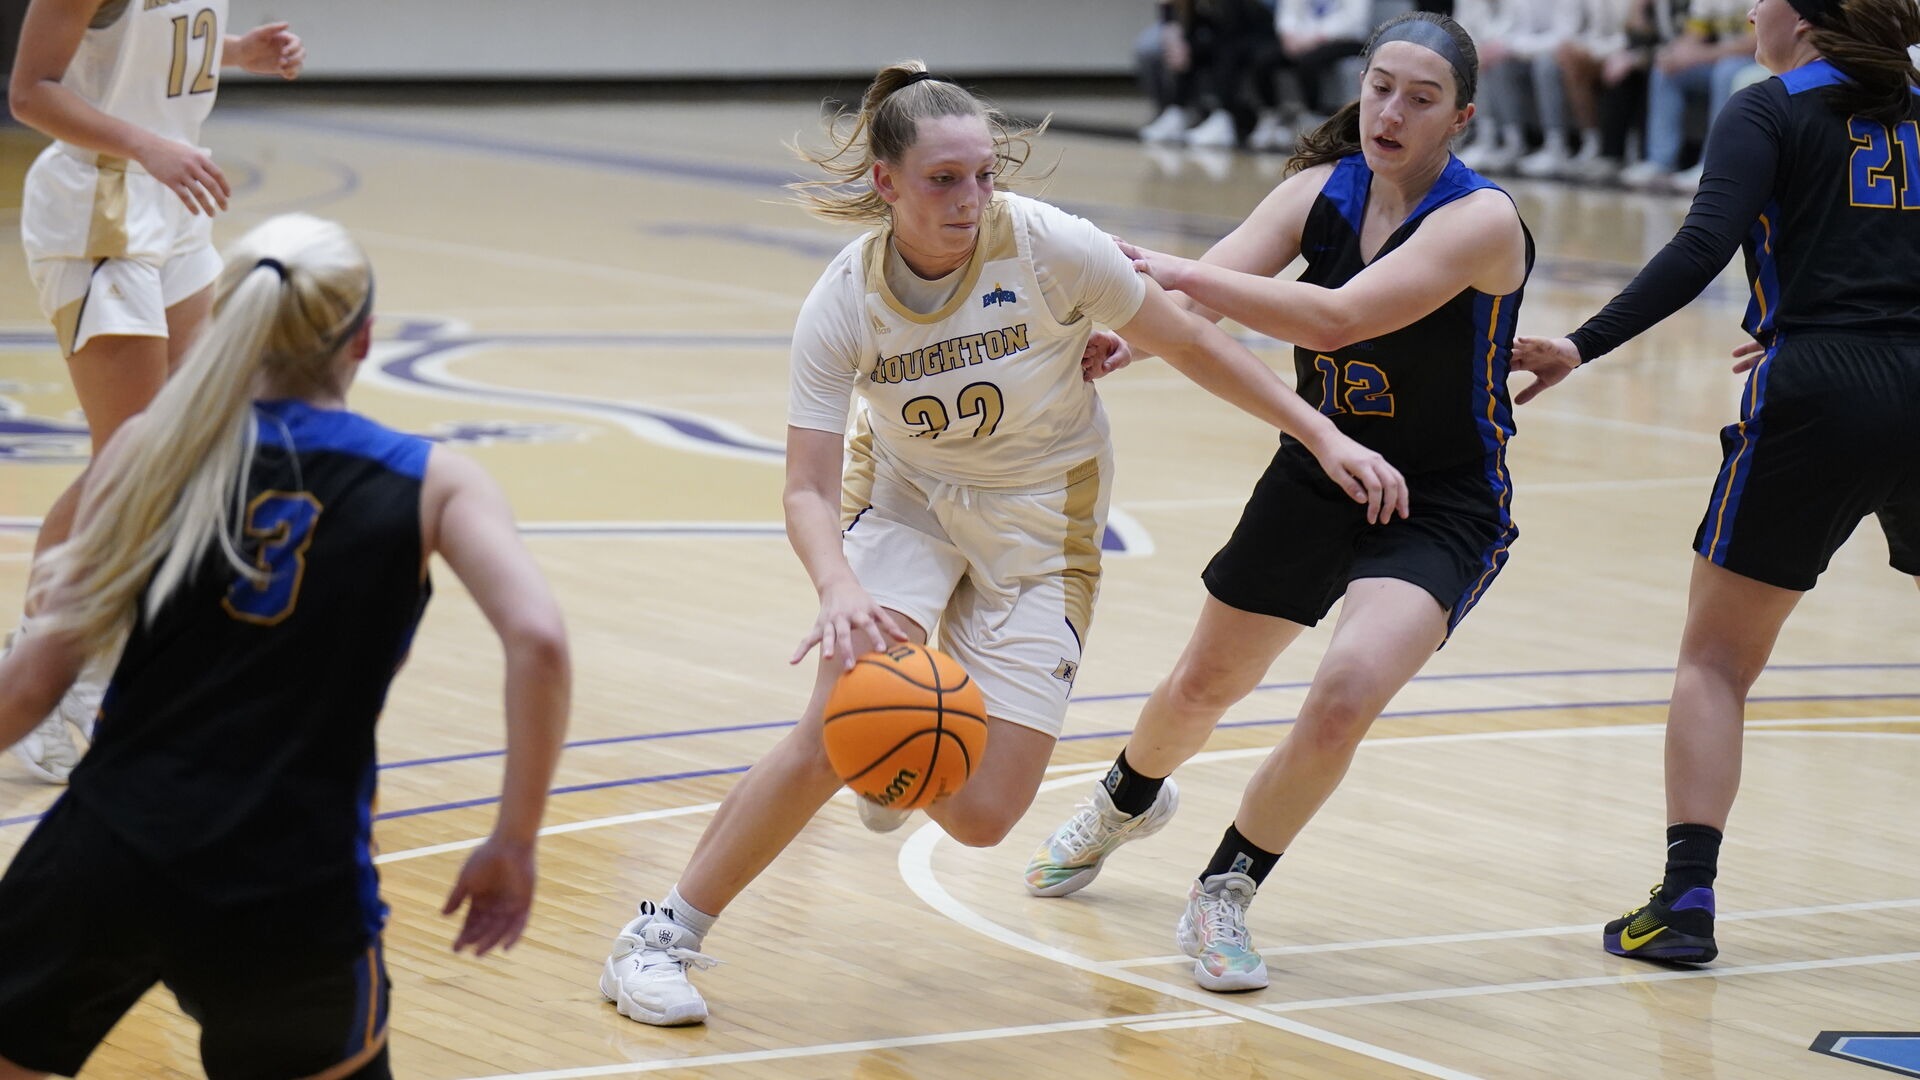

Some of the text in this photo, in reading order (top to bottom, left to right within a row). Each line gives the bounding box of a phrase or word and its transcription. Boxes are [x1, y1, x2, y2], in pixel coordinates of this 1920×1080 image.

[167, 8, 217, 98] 12
[1847, 113, 1920, 210] 21
[1314, 354, 1395, 418] 12
[220, 489, 324, 627] 3
